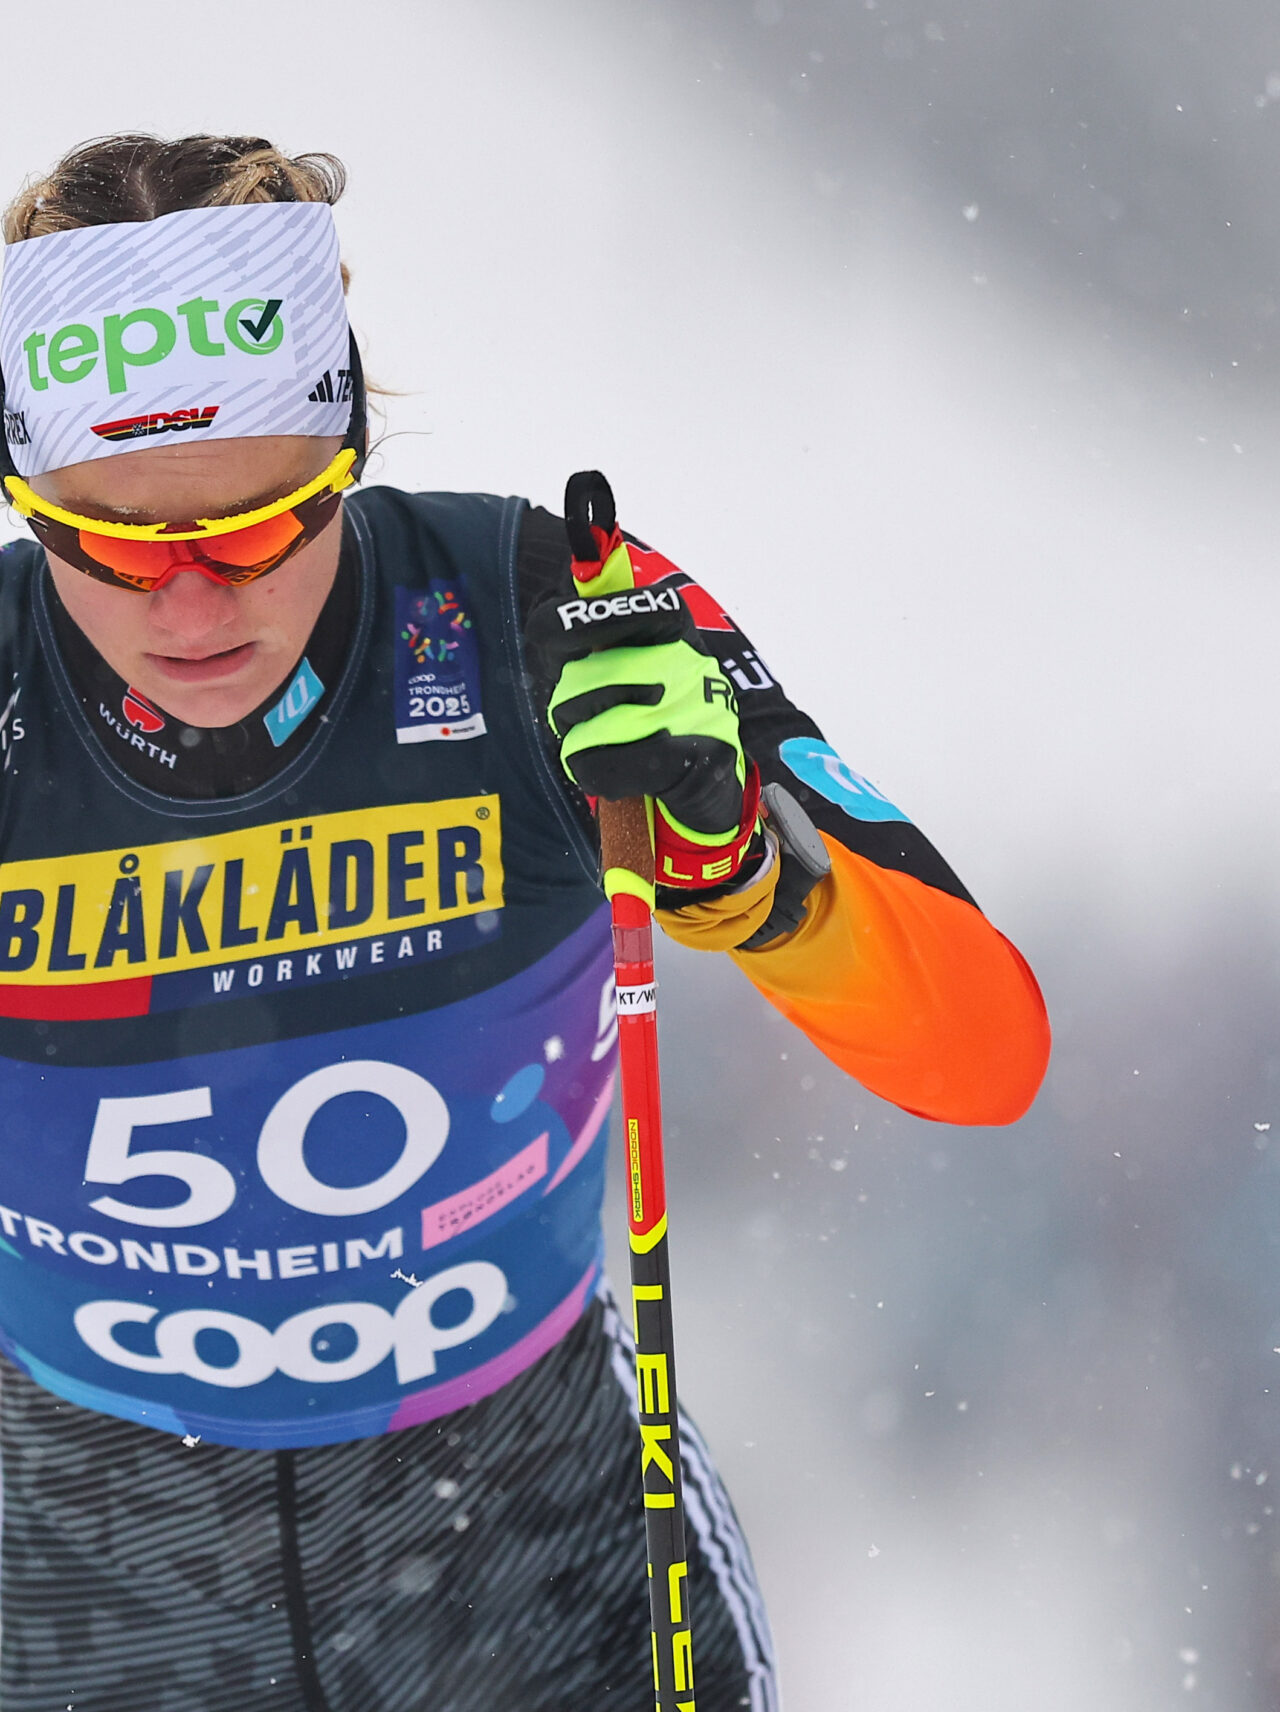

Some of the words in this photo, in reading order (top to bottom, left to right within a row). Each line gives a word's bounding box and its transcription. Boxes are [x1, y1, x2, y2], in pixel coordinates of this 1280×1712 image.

[24, 296, 284, 395] tepto
[336, 369, 353, 402] TE
[147, 405, 220, 435] DSV
[100, 702, 177, 769] WÜRTH
[409, 694, 471, 718] 2025
[213, 929, 442, 993] WORKWEAR
[84, 1061, 450, 1228] 50
[629, 1121, 639, 1171] NORDIC
[632, 1172, 642, 1219] SHARK
[74, 1260, 509, 1388] coop
[631, 1284, 676, 1509] LEKI
